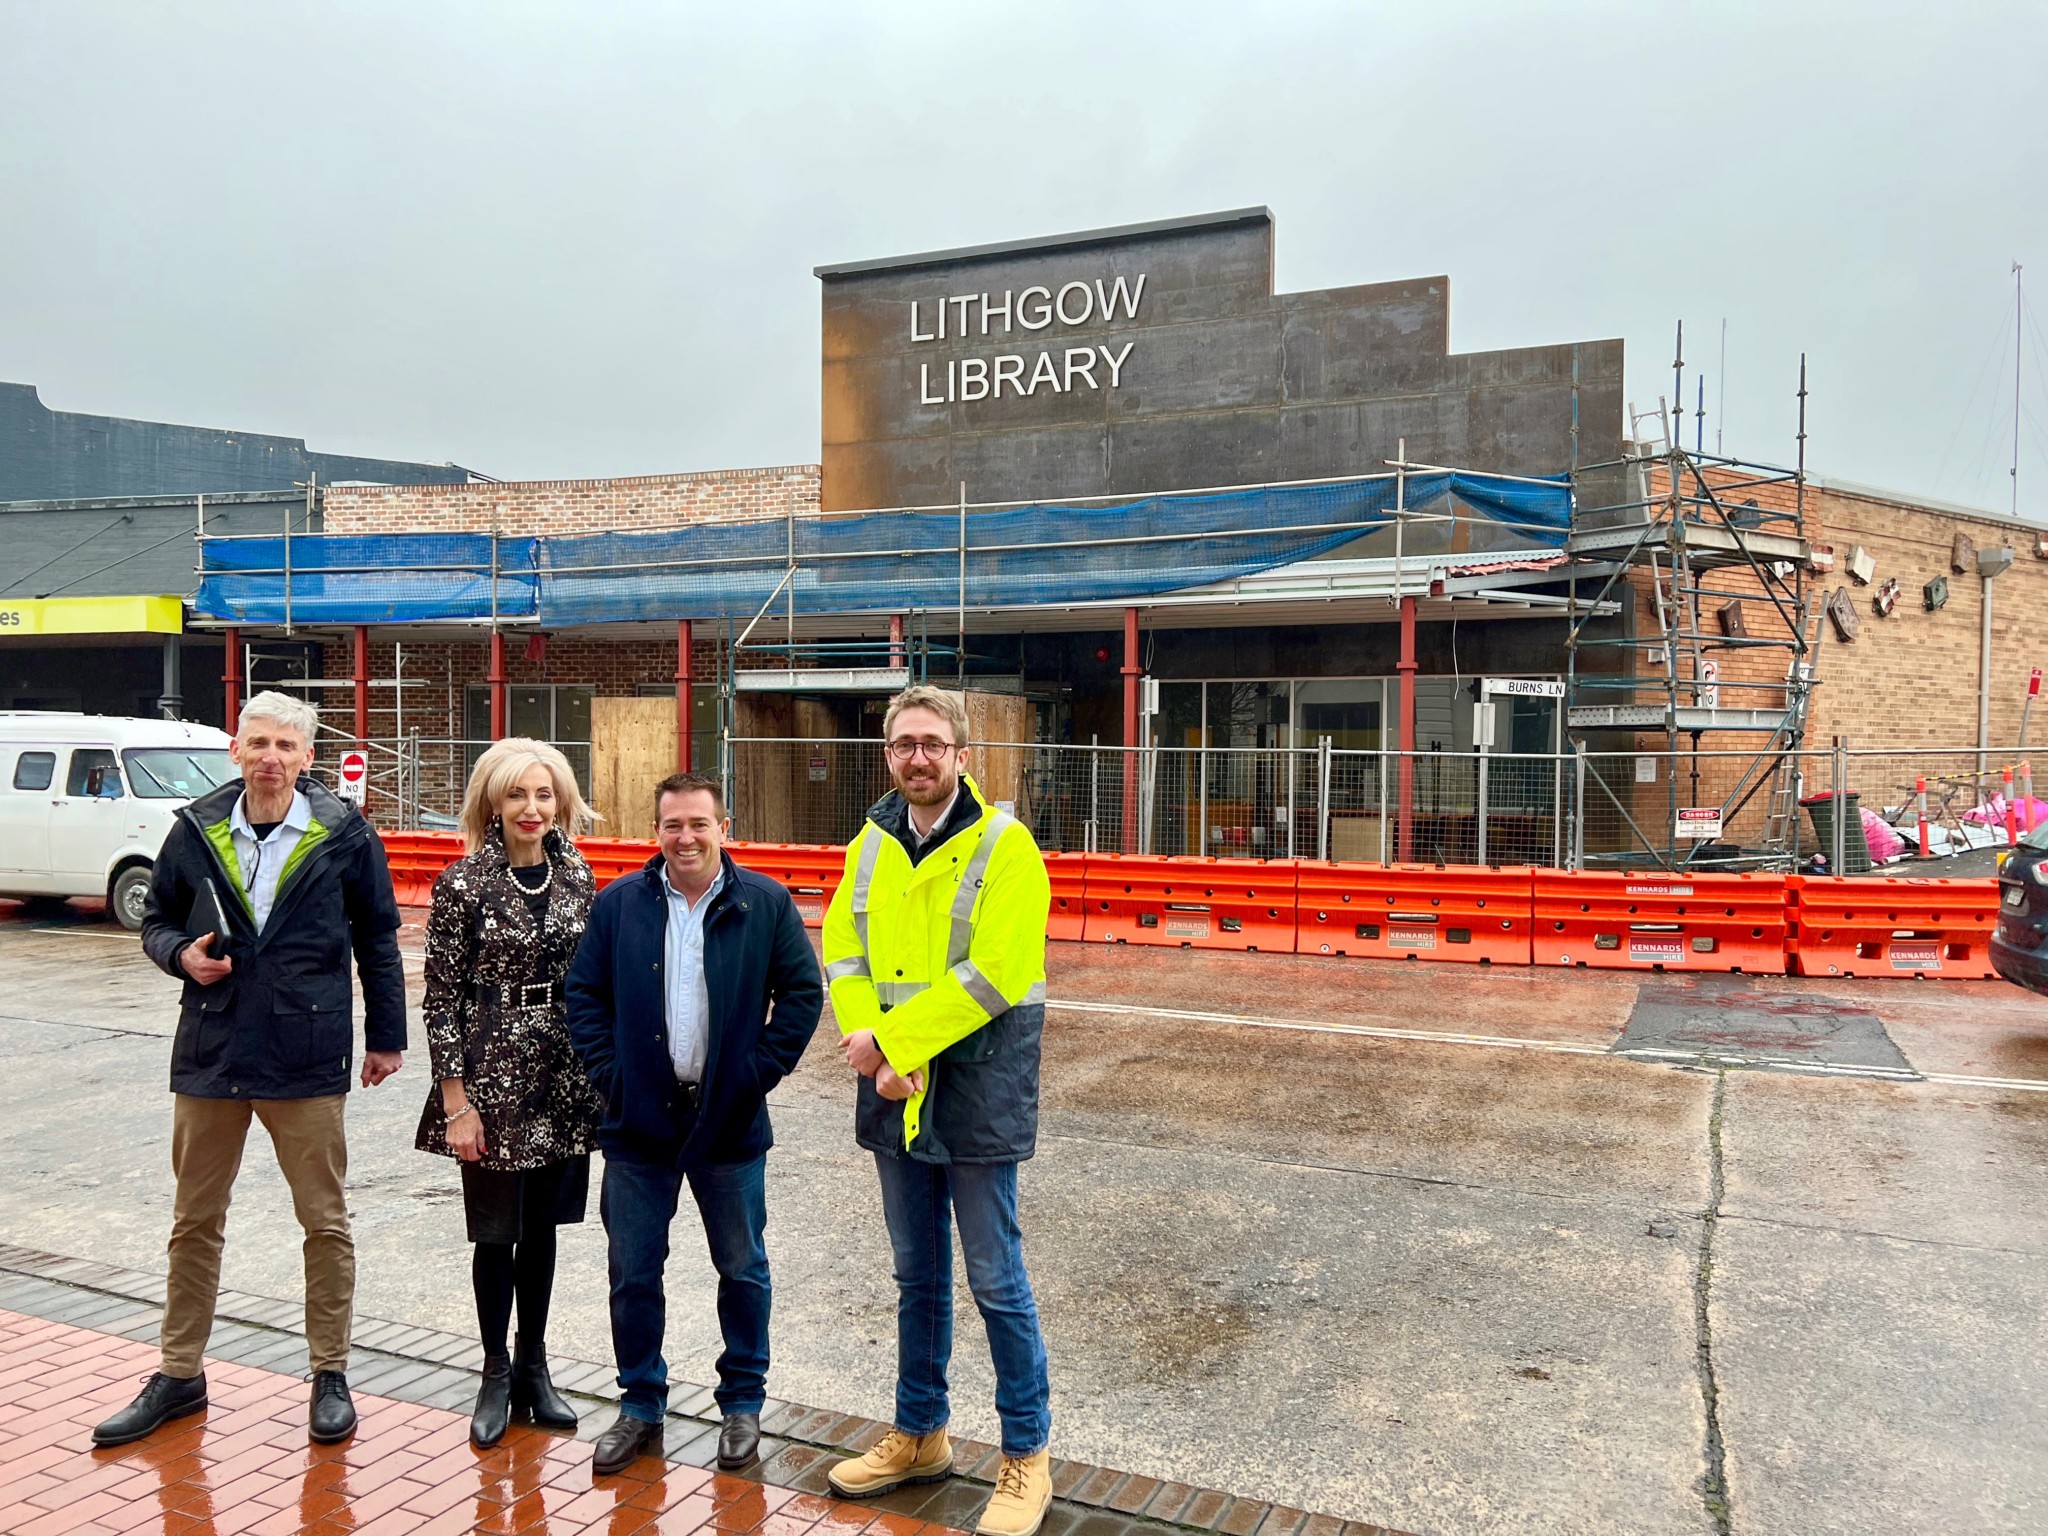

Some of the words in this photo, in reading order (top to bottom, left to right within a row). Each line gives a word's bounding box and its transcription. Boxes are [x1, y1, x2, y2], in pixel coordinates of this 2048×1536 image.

[910, 273, 1146, 342] LITHGOW
[921, 342, 1134, 405] LIBRARY
[1508, 681, 1543, 694] BURNS
[1548, 684, 1563, 695] LN
[345, 784, 359, 793] NO
[1628, 885, 1668, 893] KENNARDS
[1673, 886, 1690, 894] HIRE
[1167, 921, 1208, 930] KENNARDS
[1191, 930, 1208, 938] HIRE
[1390, 931, 1434, 940] KENNARDS
[1631, 943, 1681, 952] KENNARDS
[1890, 951, 1936, 960] KENNARDS
